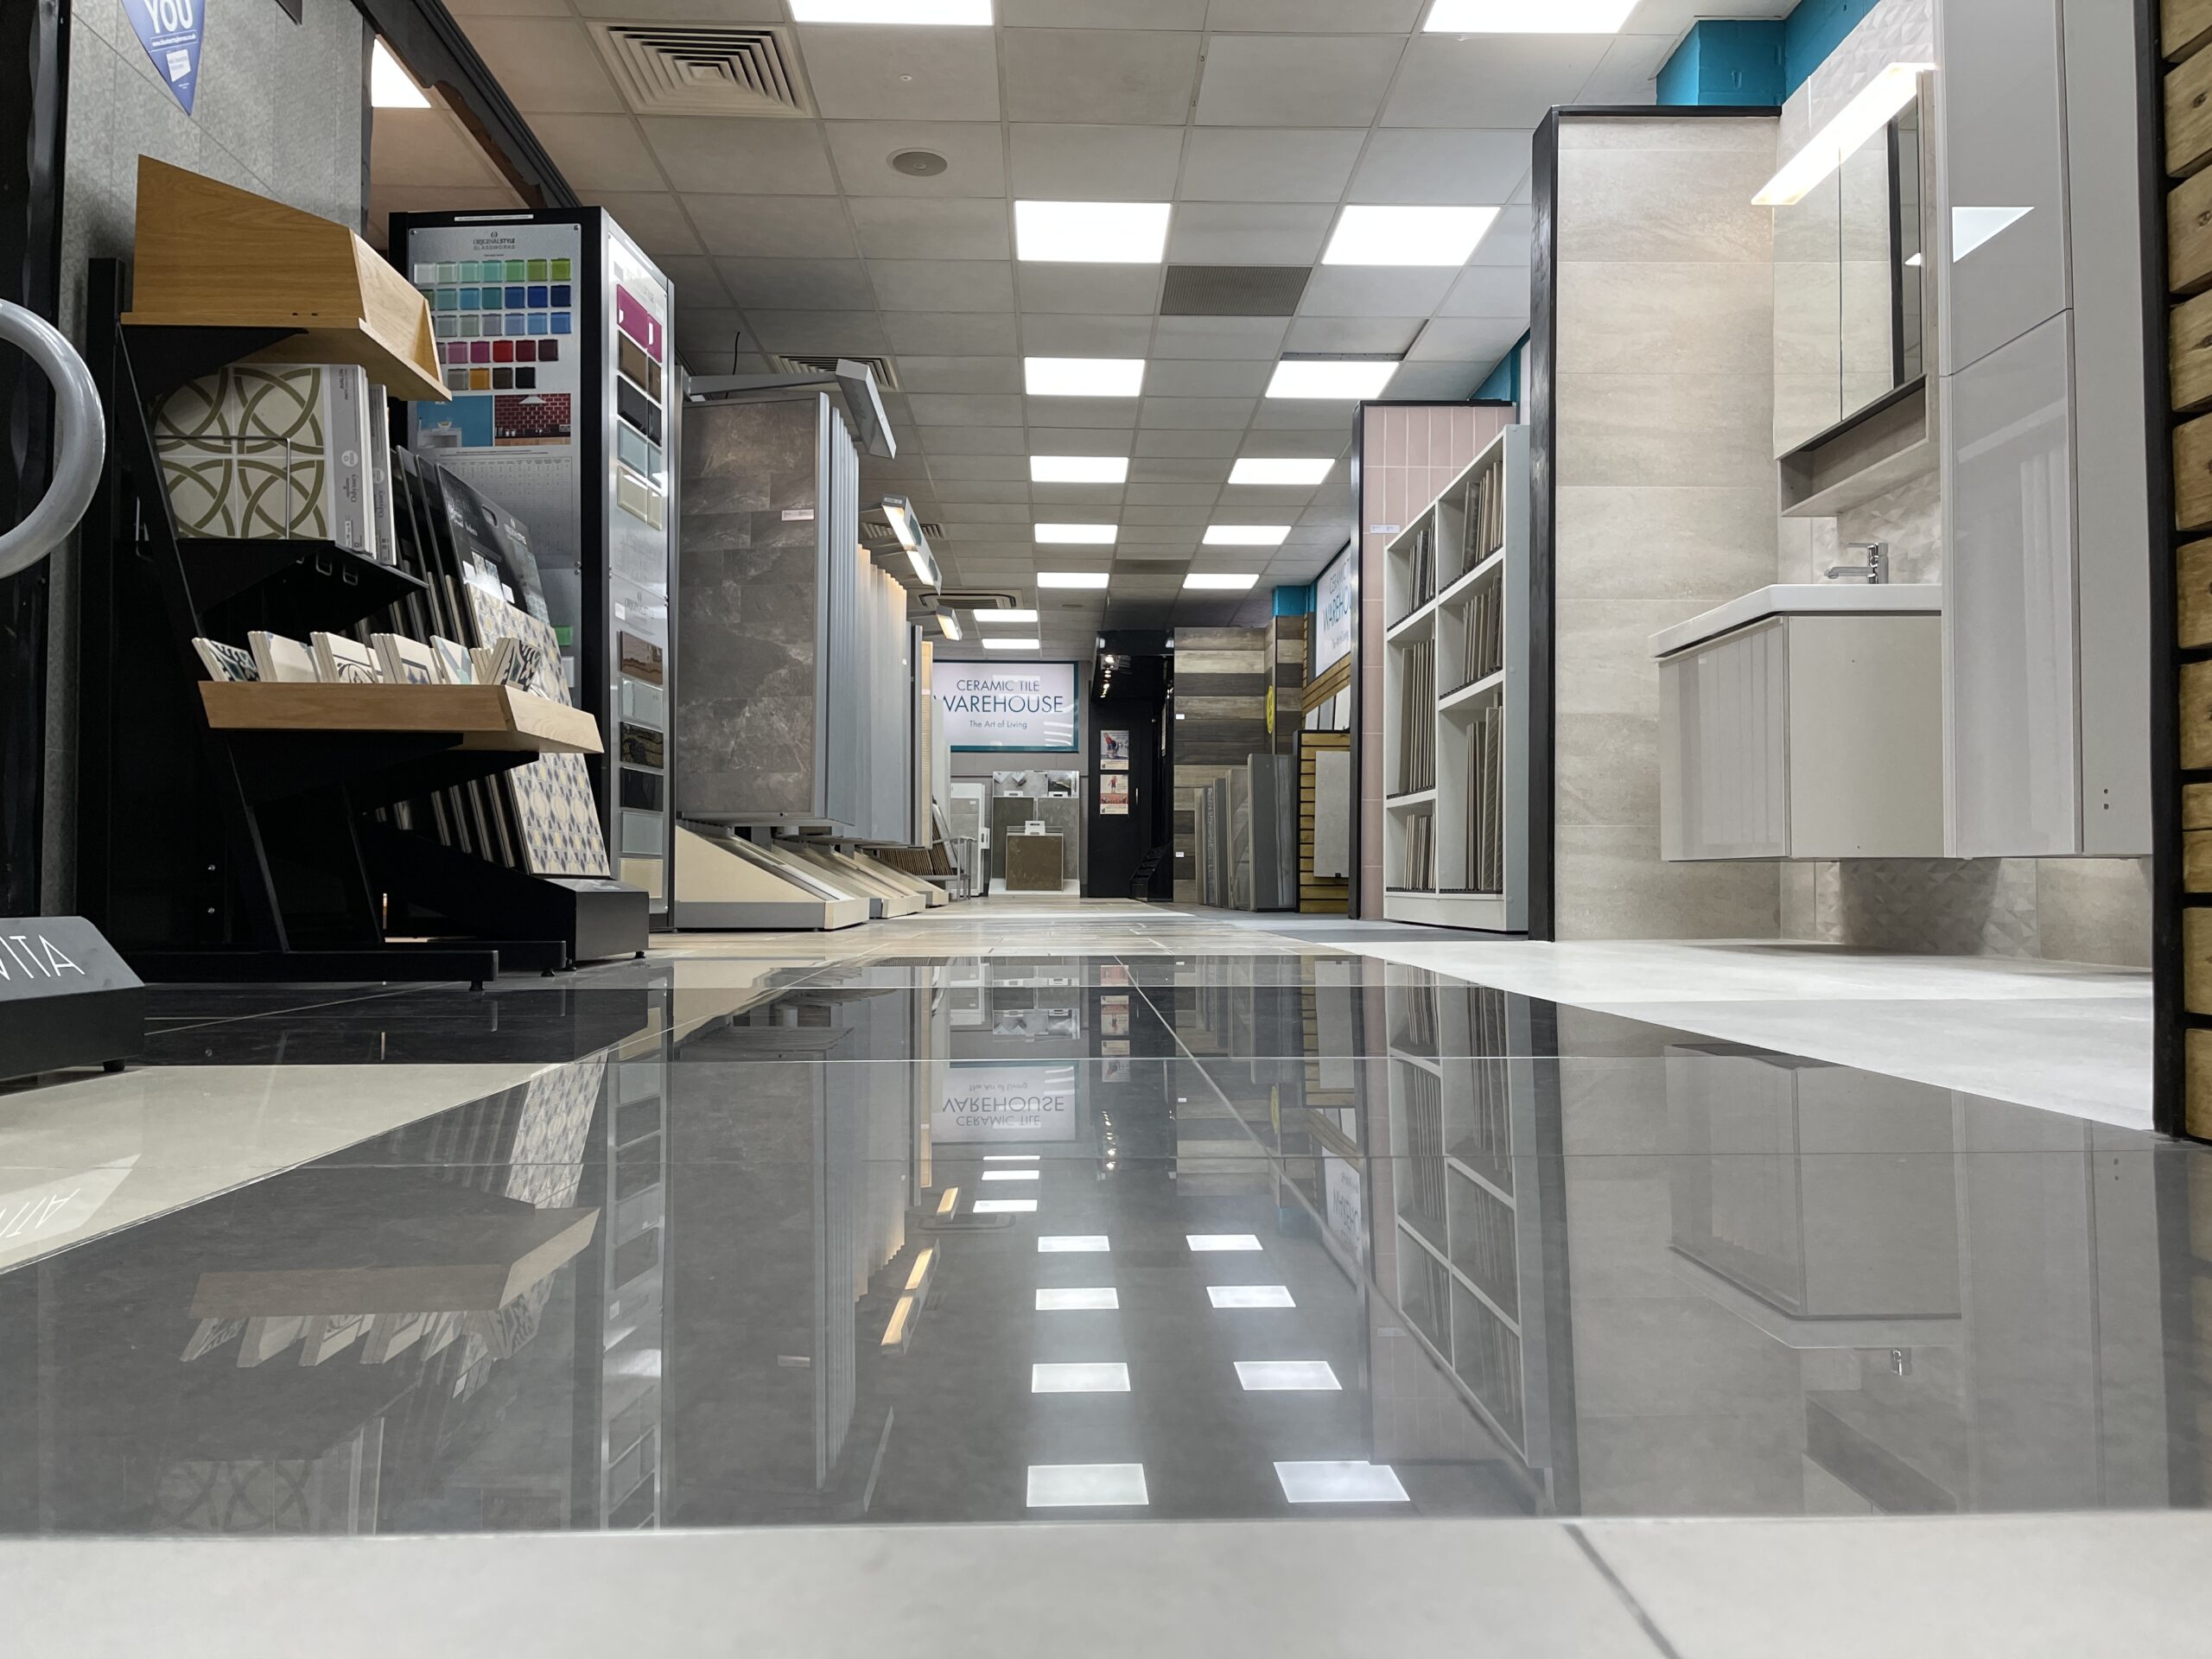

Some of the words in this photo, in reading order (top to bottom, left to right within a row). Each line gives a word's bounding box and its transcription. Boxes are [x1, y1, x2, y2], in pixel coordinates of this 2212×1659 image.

[143, 0, 194, 34] YOU
[1323, 585, 1351, 632] WAREHO
[957, 679, 1014, 691] CERAMIC
[1019, 680, 1039, 691] TILE
[1007, 720, 1027, 729] Living
